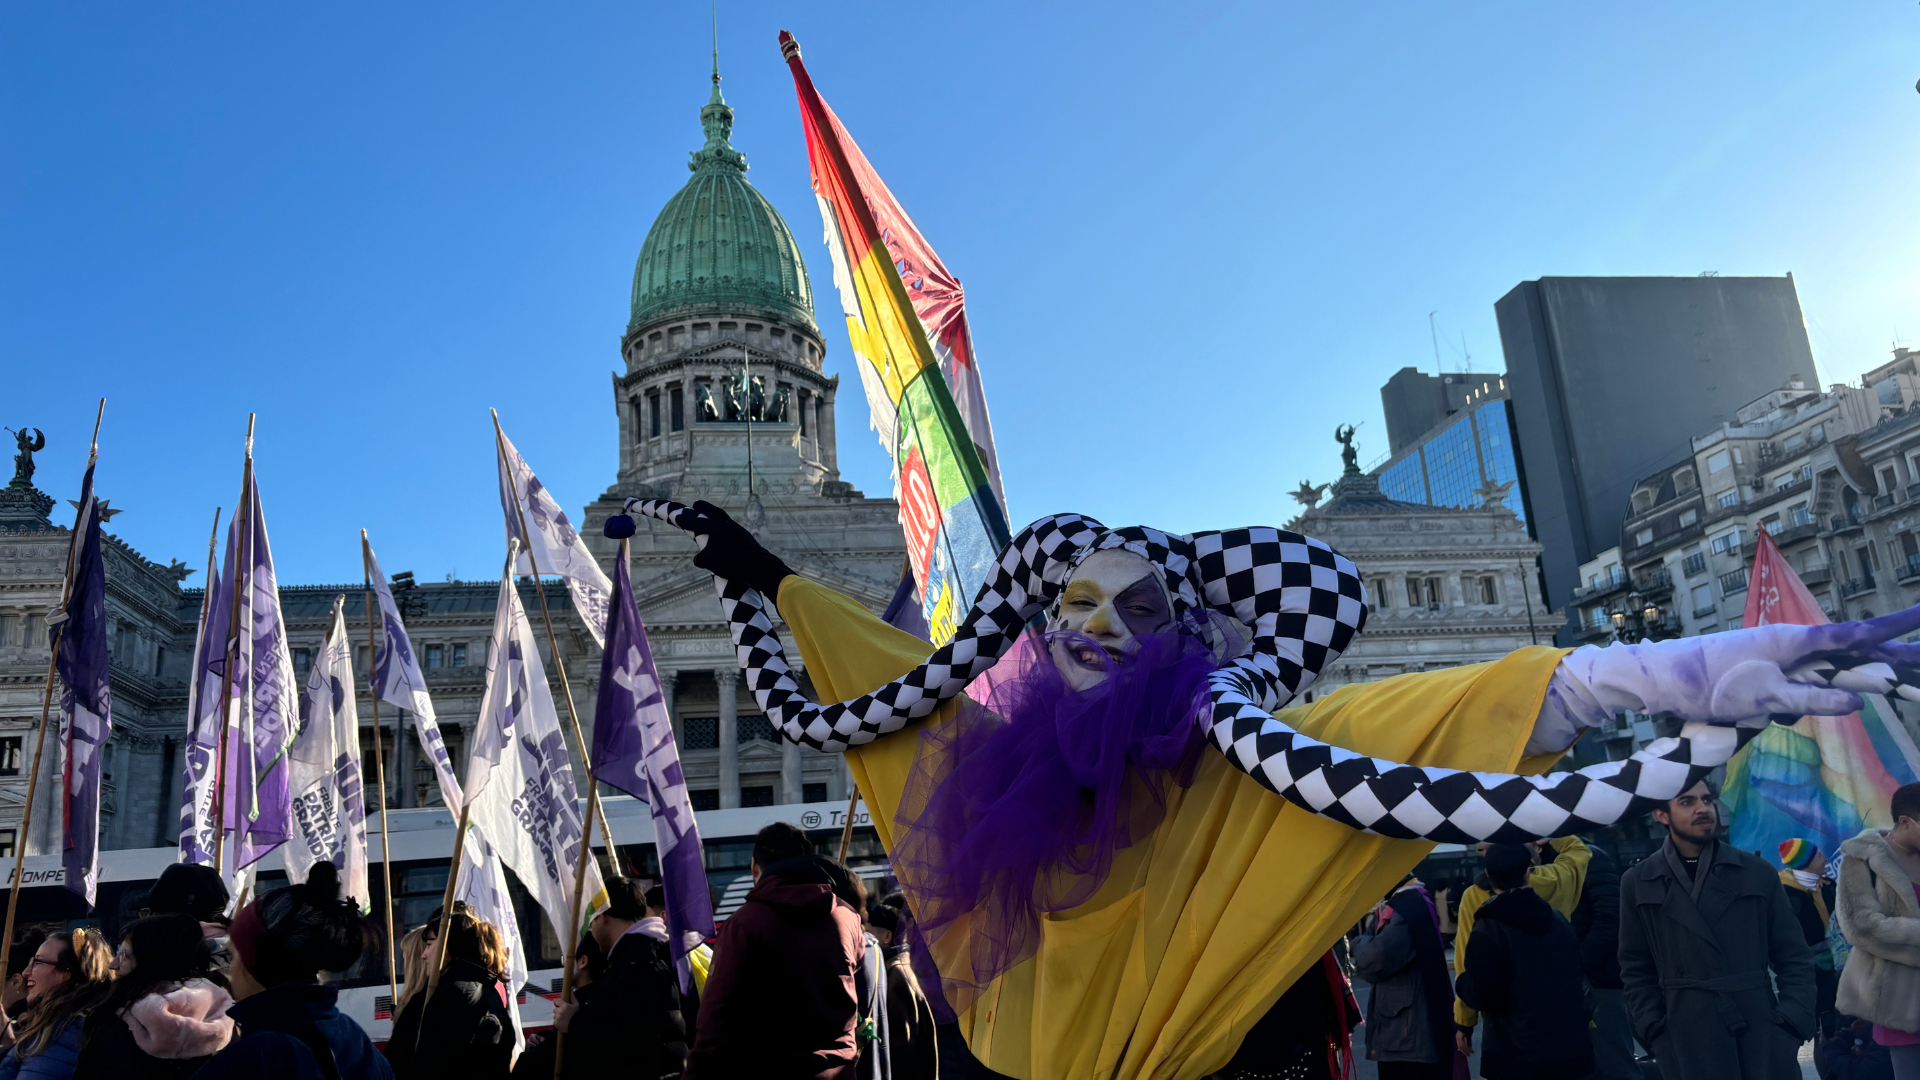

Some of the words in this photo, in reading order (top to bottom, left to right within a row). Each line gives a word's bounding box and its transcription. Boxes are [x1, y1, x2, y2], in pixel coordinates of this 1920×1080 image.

[685, 641, 730, 653] CONGR
[303, 791, 340, 857] PATRIA
[317, 786, 342, 829] FRENTE
